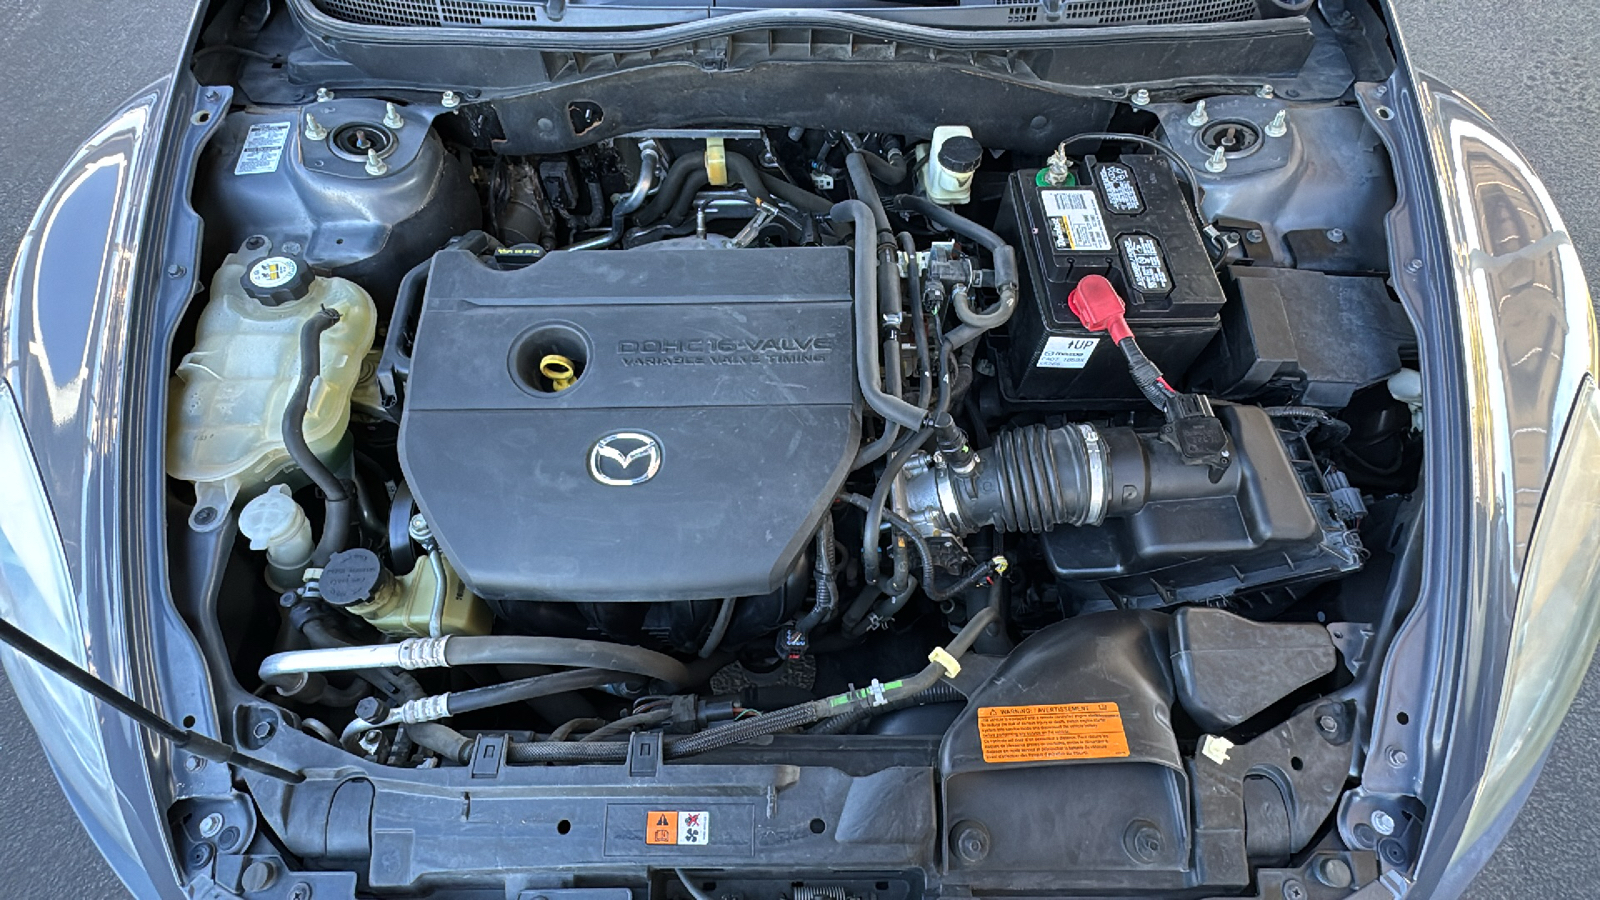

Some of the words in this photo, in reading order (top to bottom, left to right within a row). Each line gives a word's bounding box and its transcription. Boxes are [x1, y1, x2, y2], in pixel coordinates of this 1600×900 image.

[617, 339, 704, 355] DOHC
[1074, 340, 1094, 350] UP
[621, 356, 704, 367] VARIABLE
[709, 355, 761, 366] VALVE
[765, 354, 826, 365] TIMING
